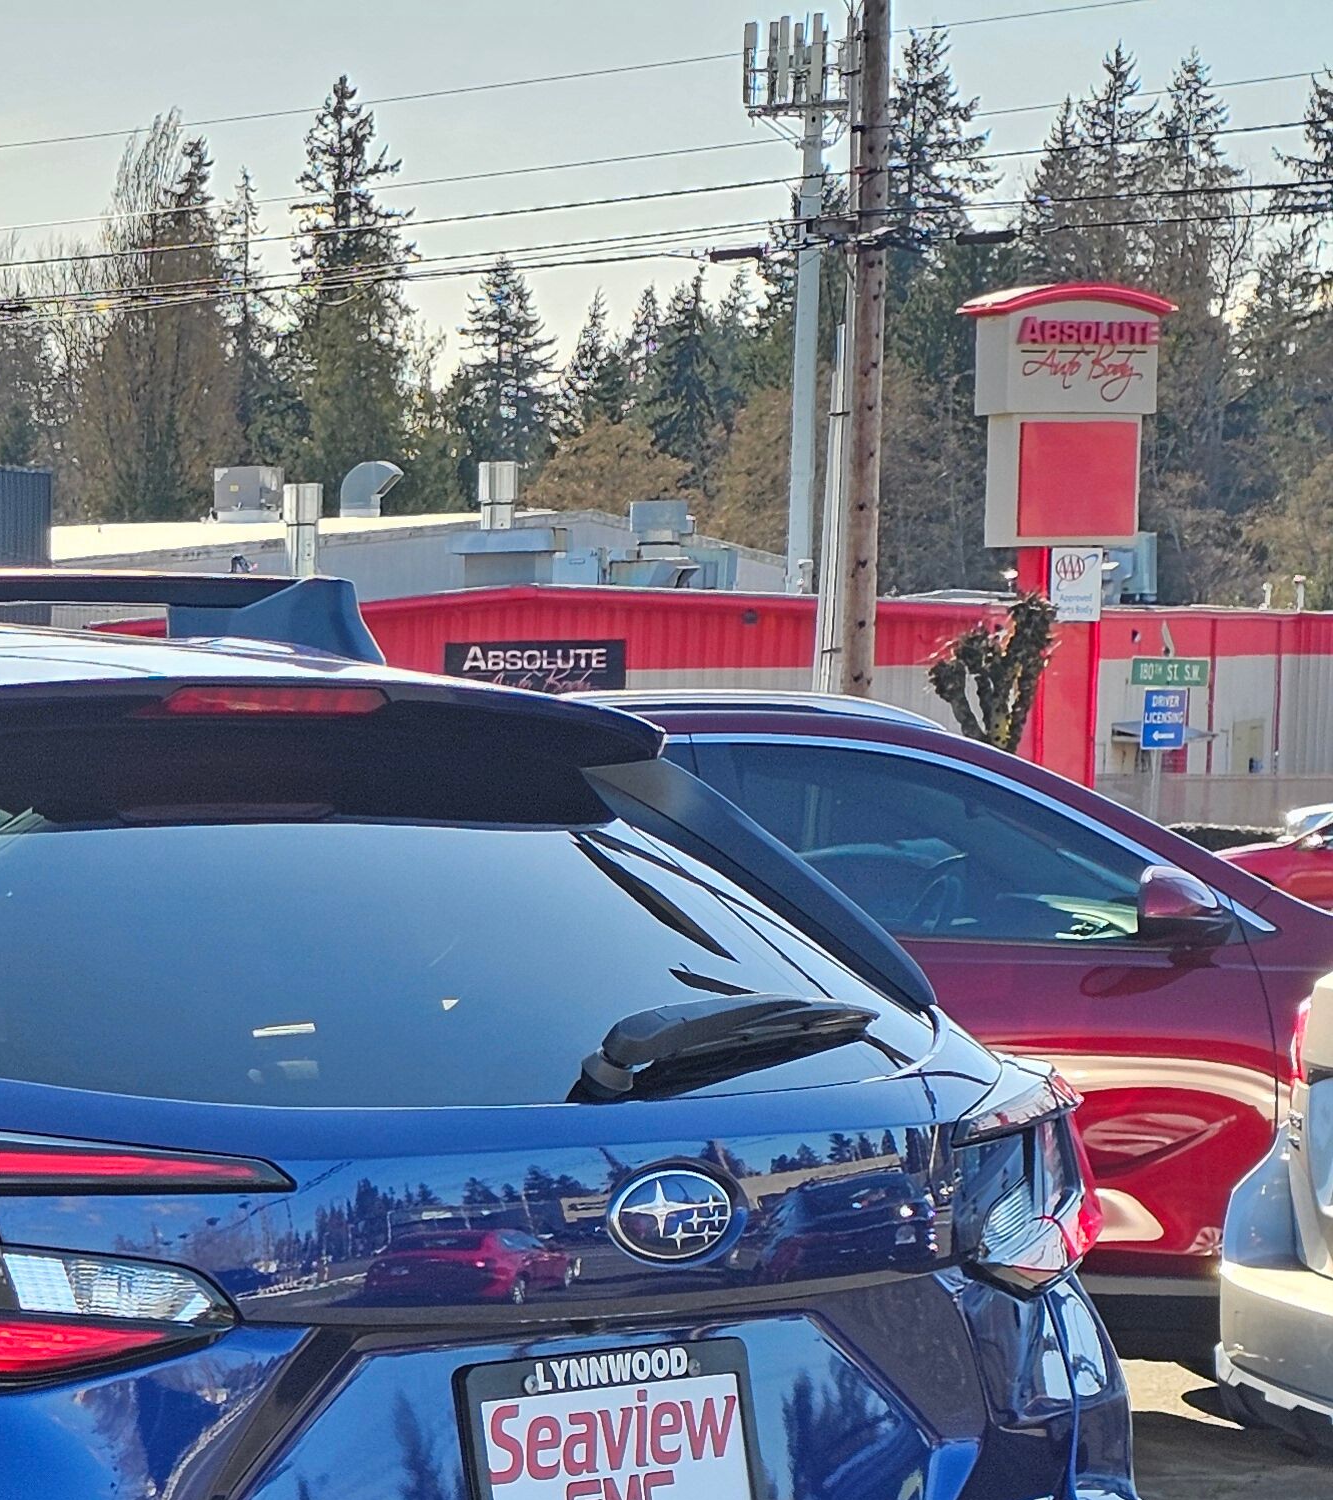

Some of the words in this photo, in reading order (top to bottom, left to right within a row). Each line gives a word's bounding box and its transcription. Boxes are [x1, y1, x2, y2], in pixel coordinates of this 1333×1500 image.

[1017, 316, 1160, 345] ABSOLUTE
[1022, 347, 1084, 389] Auto
[1087, 344, 1143, 402] Body
[1057, 555, 1085, 581] AAA
[462, 645, 608, 672] ABSOLUTE
[1151, 695, 1180, 708] DRIVER
[1144, 711, 1184, 724] LICENSING
[534, 1346, 689, 1392] LYNNWOOD
[489, 1388, 737, 1486] Seaview
